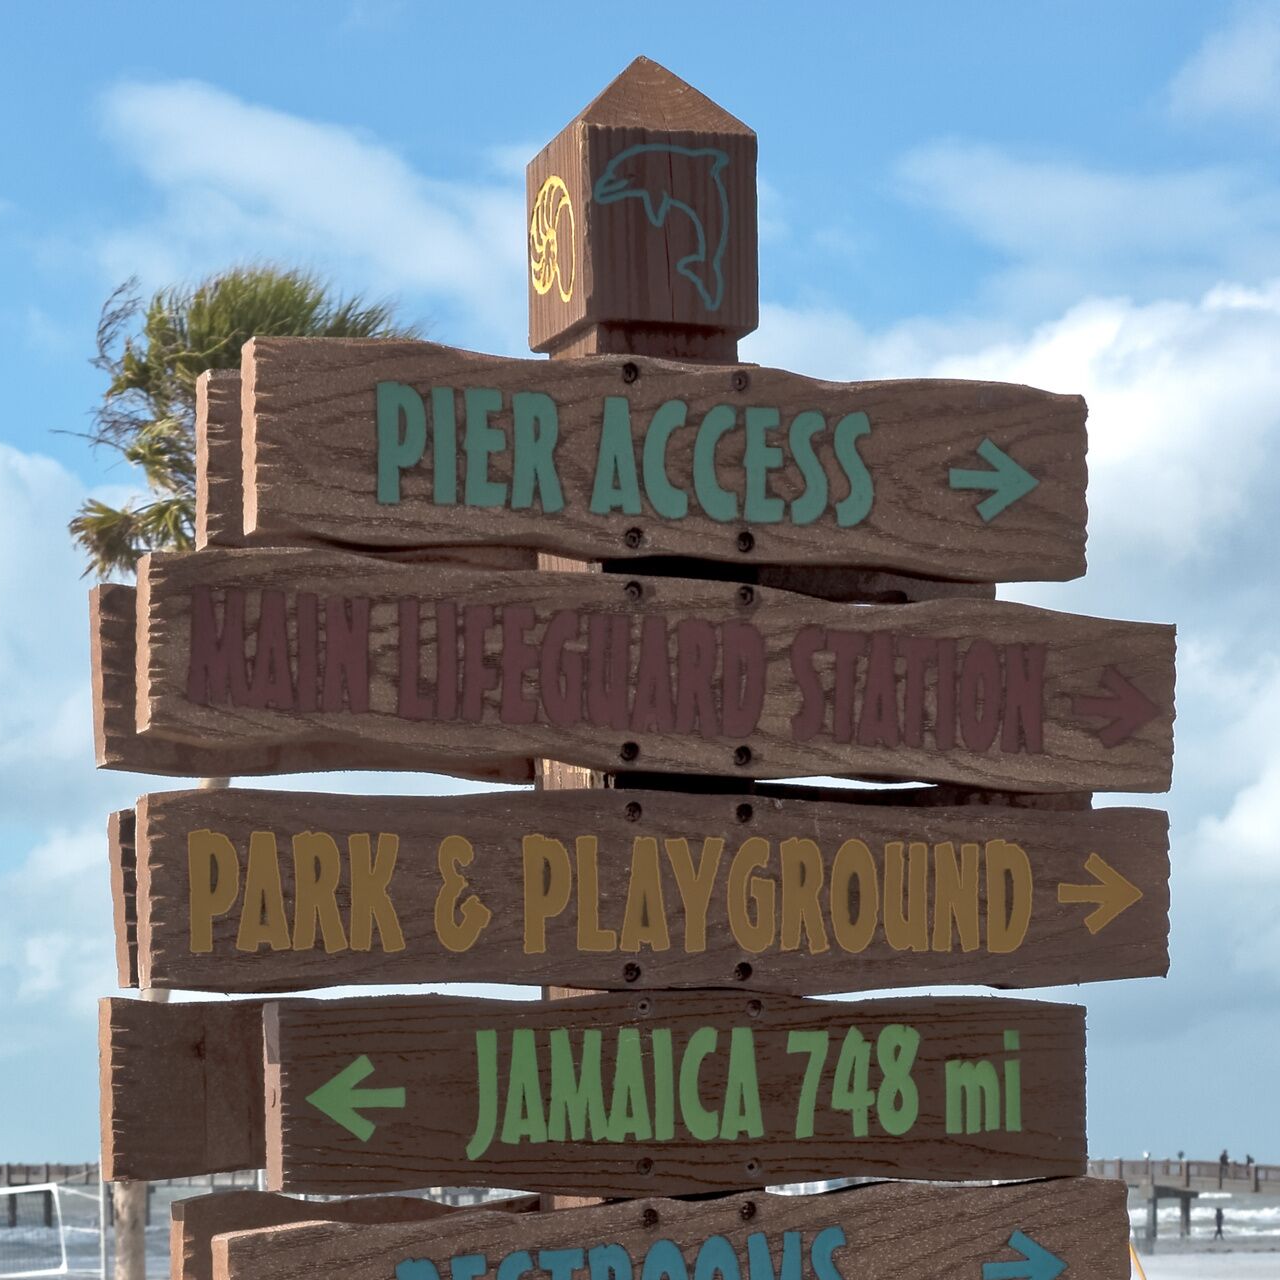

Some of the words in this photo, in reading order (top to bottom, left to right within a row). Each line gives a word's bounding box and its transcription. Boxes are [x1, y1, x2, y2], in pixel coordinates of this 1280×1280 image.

[376, 381, 565, 513] PIER
[591, 397, 873, 527] ACCESS
[188, 588, 369, 715] MAIN
[397, 604, 767, 739] LIFEGUARD
[792, 626, 1049, 754] STATION
[188, 830, 406, 954] PARK
[436, 836, 492, 953] &
[522, 832, 1034, 955] PLAYGROUND
[467, 1027, 766, 1160] JAMAICA
[786, 1024, 921, 1138] 748
[945, 1031, 1023, 1136] mi
